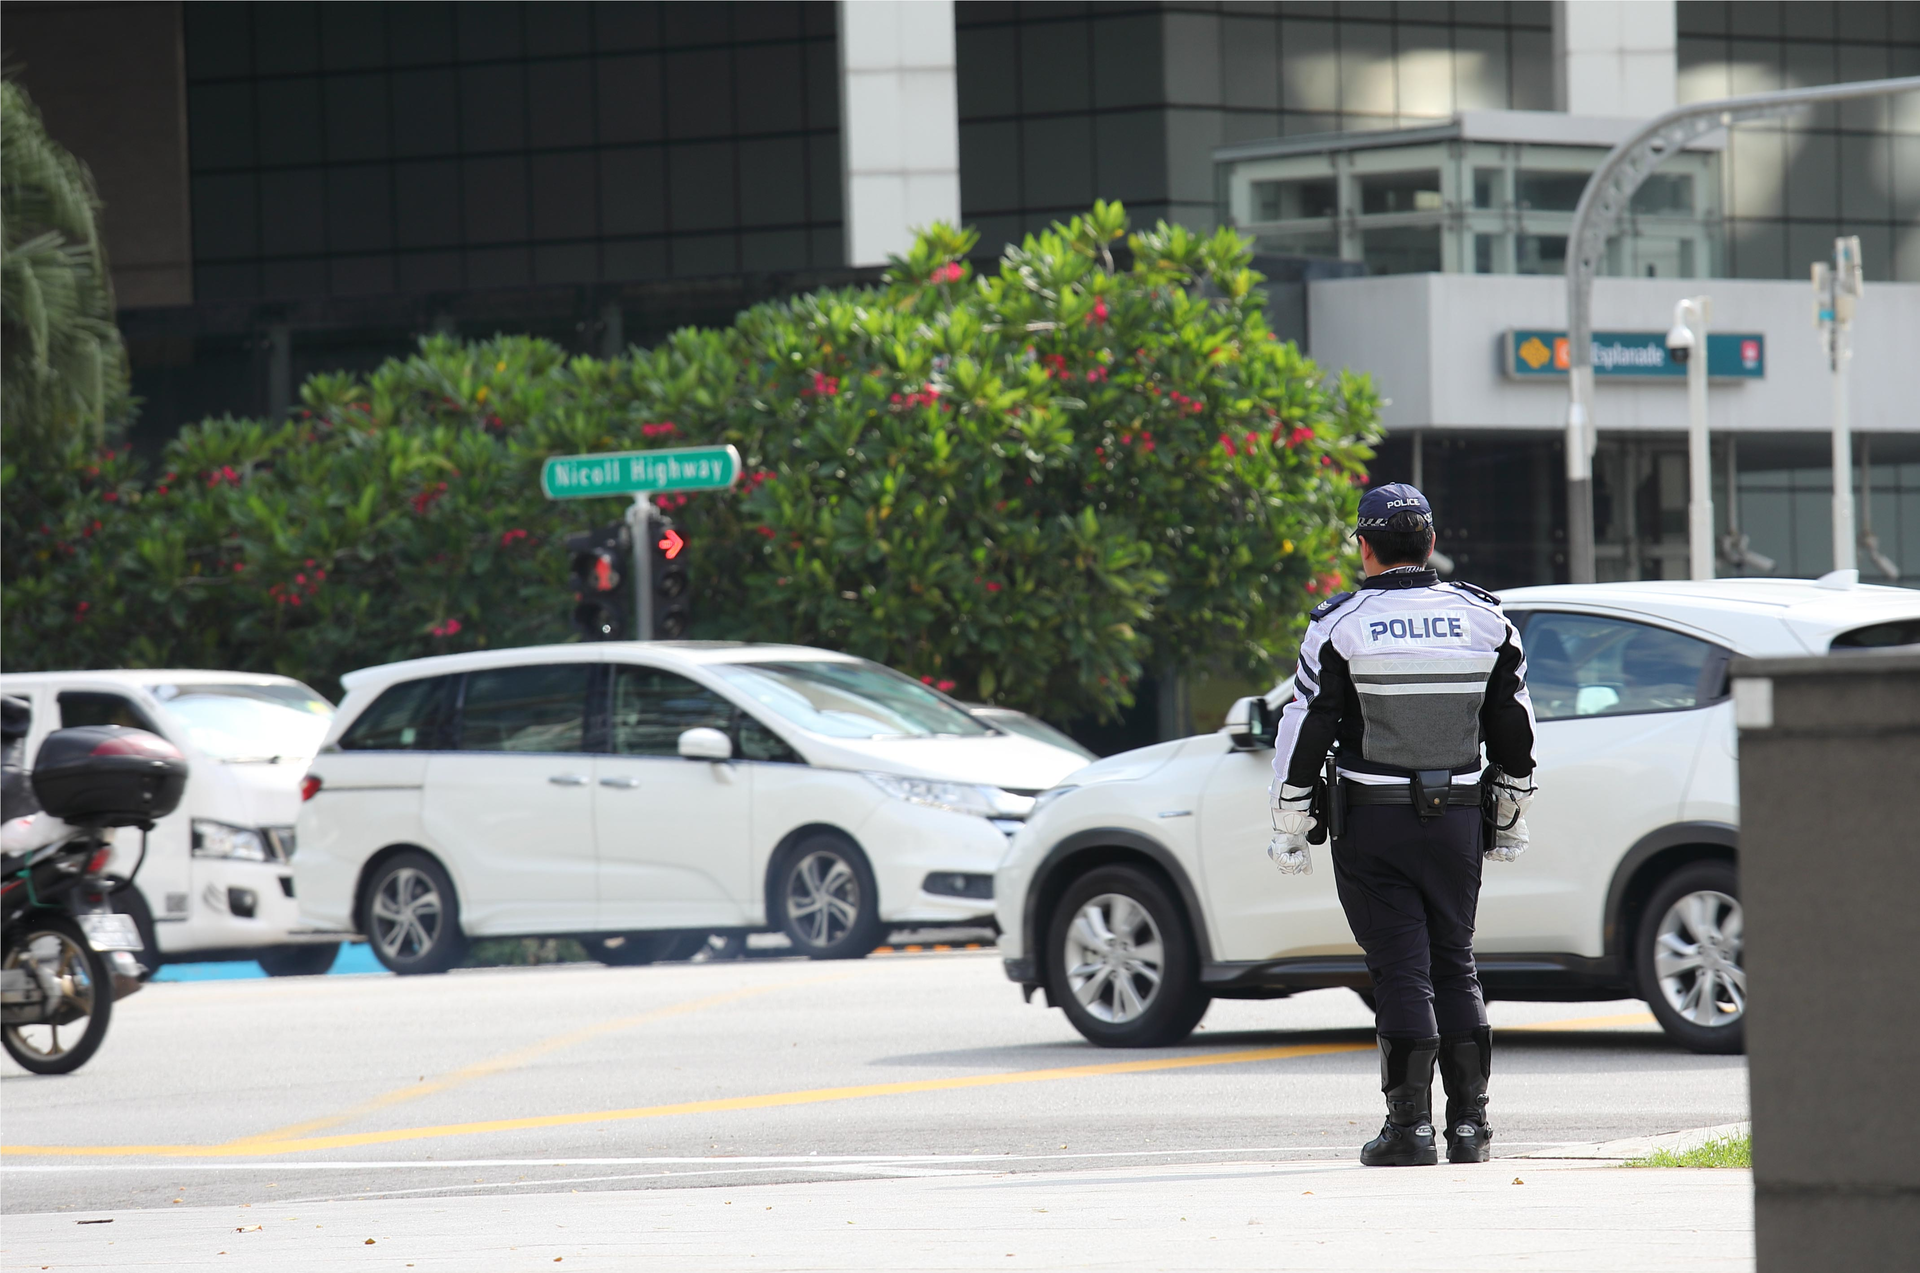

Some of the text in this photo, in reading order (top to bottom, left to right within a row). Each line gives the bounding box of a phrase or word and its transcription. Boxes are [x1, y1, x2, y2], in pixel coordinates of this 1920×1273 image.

[1591, 341, 1665, 371] Esplanade
[554, 457, 723, 487] Nicoll Highway
[1386, 498, 1421, 509] POLICE
[1369, 617, 1464, 642] POLICE
